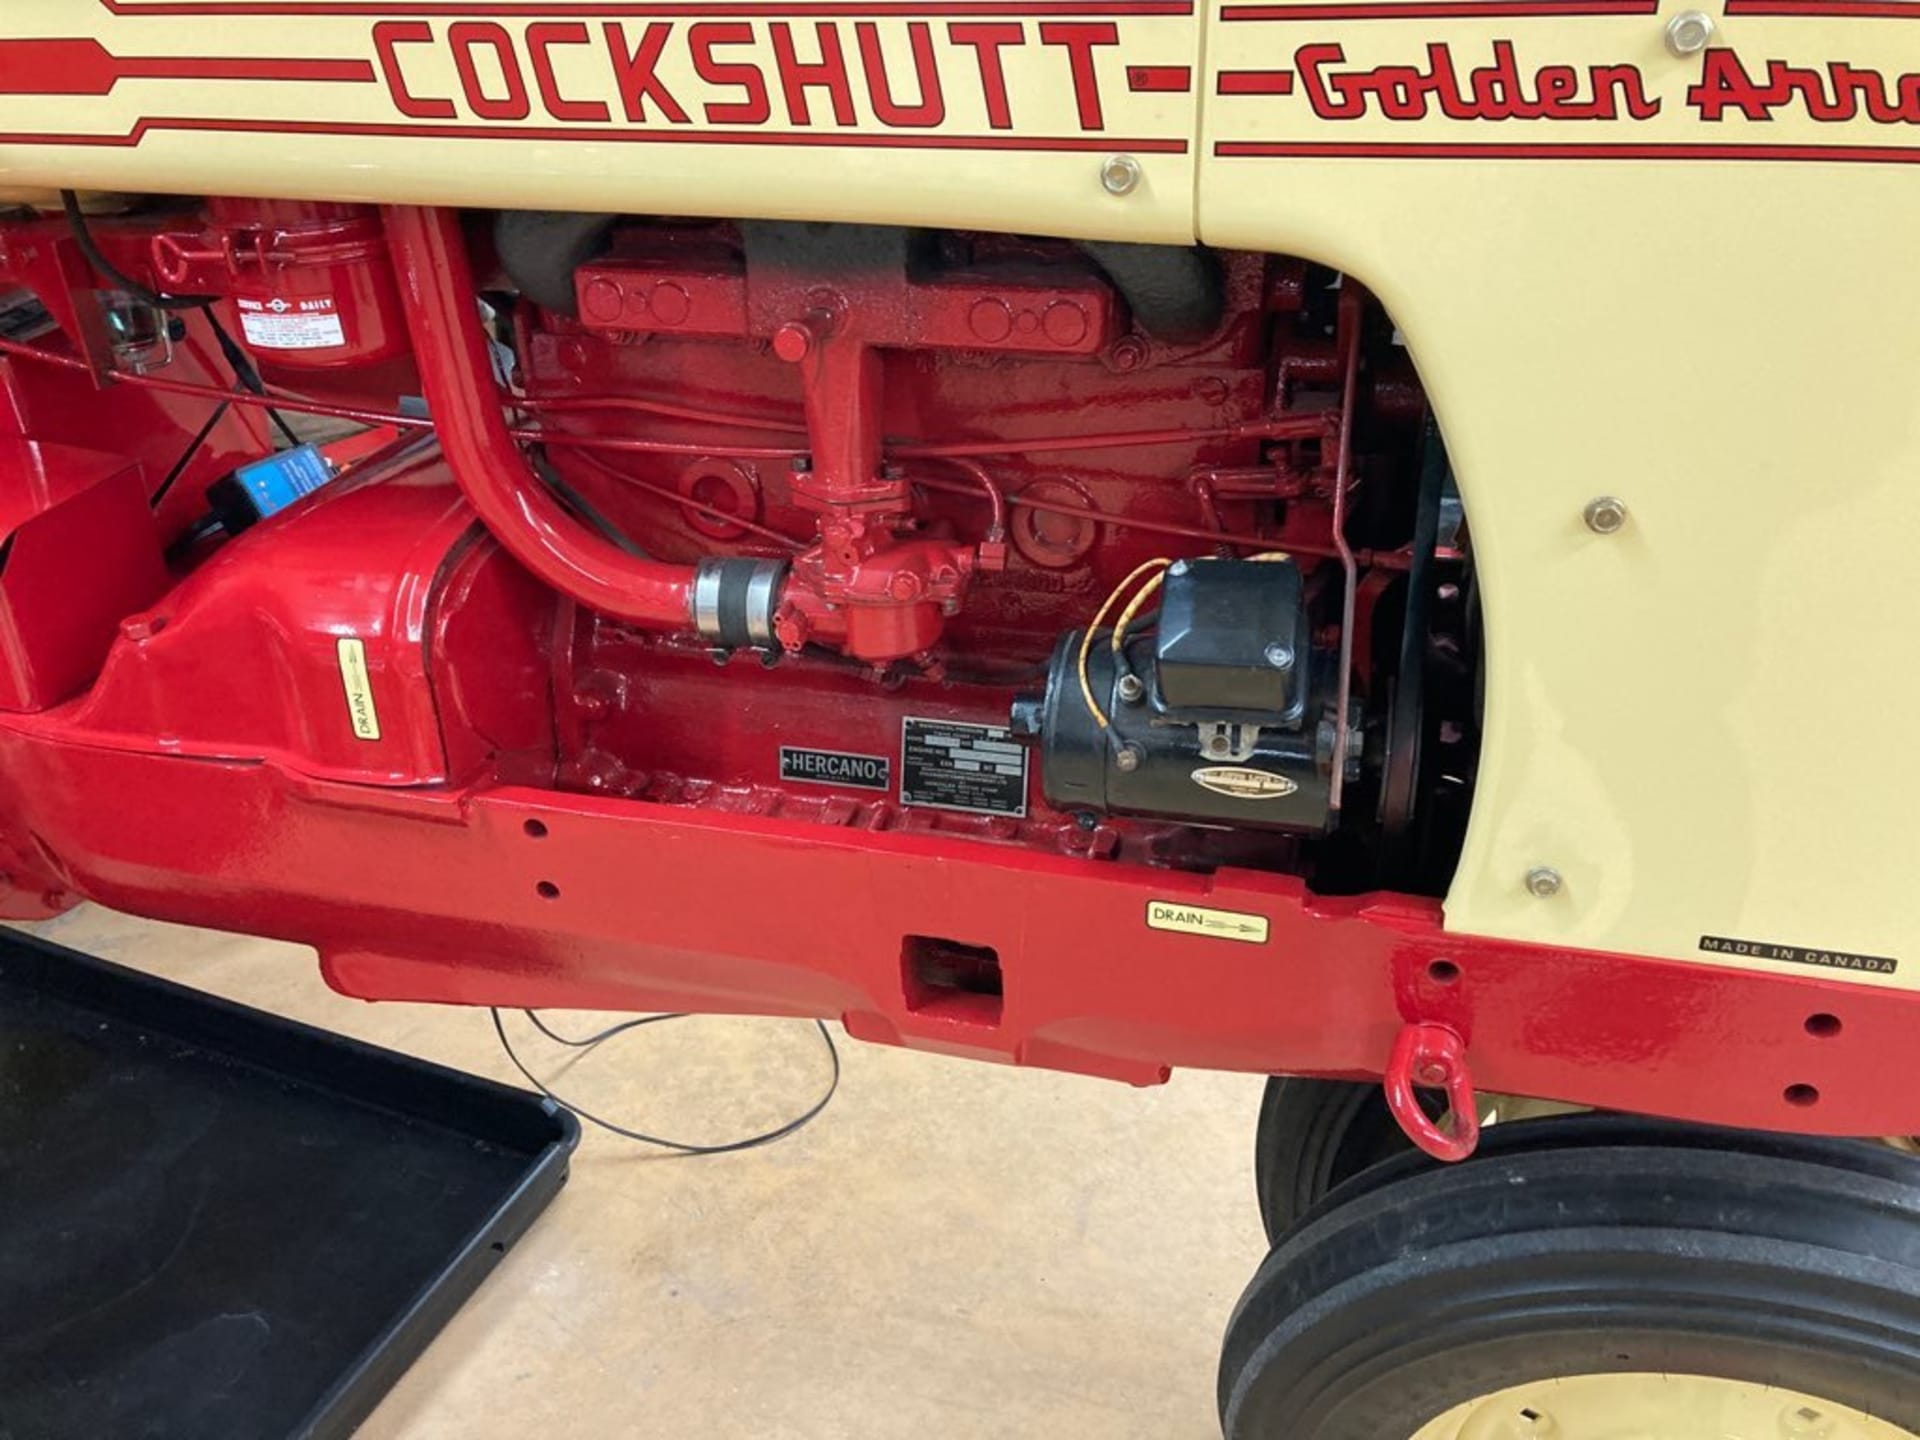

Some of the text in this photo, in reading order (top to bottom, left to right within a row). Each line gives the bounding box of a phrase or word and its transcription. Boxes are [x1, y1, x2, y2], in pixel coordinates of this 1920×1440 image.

[373, 21, 1120, 131] COCKSHUTT
[1294, 40, 1661, 120] Golden
[353, 693, 371, 734] DRAIN
[792, 753, 877, 779] HERCANO
[1154, 907, 1203, 925] DRAIN
[1703, 939, 1893, 972] MADE IN CANADA
